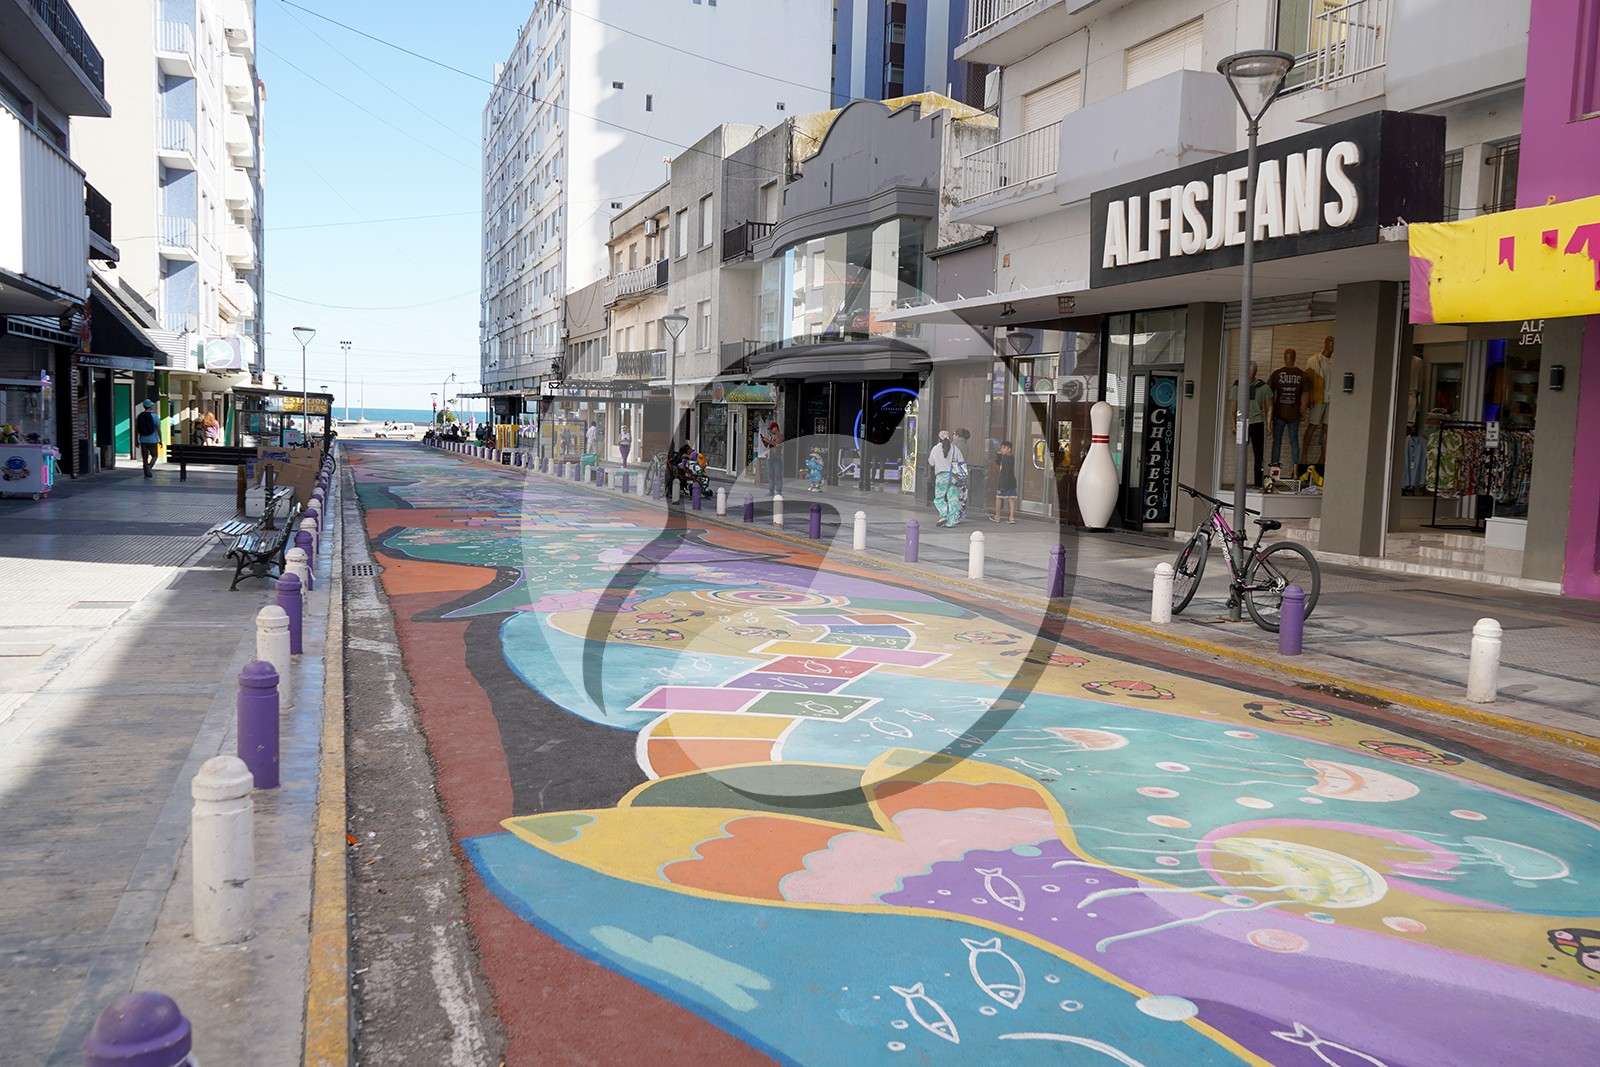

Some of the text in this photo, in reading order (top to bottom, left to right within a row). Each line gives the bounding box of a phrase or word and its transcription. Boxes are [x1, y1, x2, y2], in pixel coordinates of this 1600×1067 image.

[1102, 141, 1360, 269] ALFISJEANS
[1279, 371, 1302, 385] Dune
[1518, 333, 1545, 346] JEA
[1145, 408, 1167, 520] CHAPELCO
[1162, 421, 1173, 508] BOWLING CLUB
